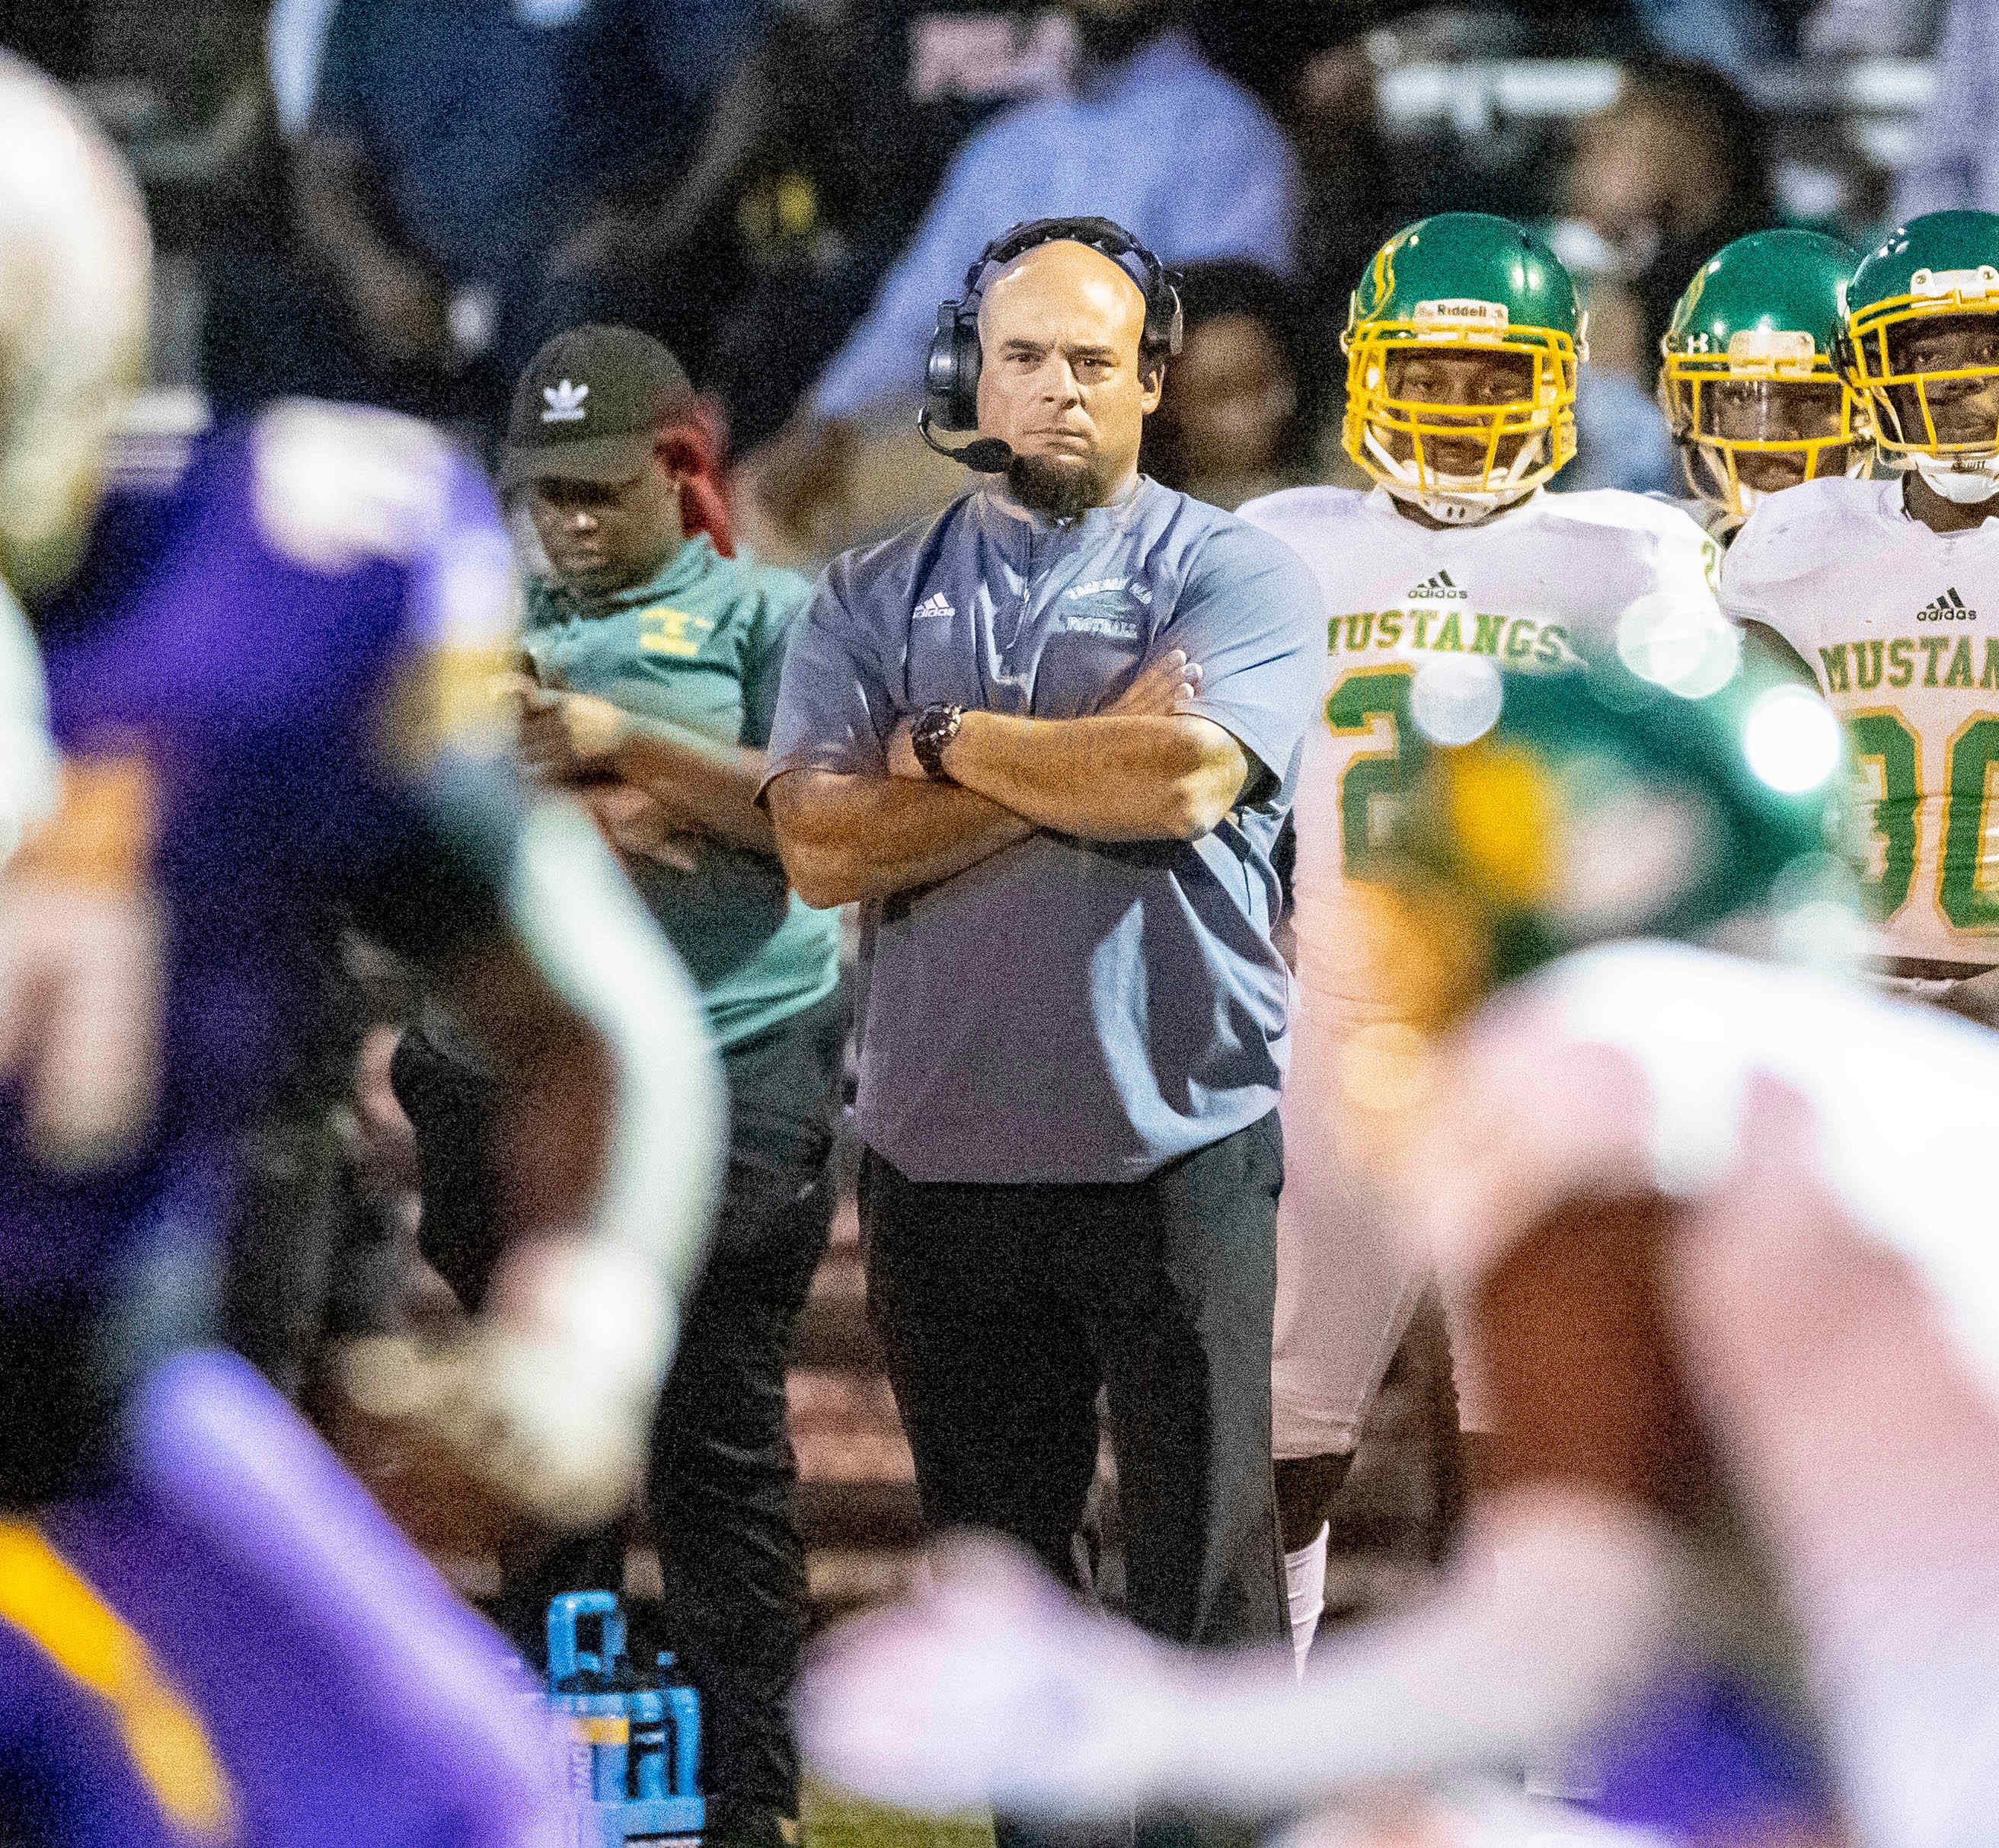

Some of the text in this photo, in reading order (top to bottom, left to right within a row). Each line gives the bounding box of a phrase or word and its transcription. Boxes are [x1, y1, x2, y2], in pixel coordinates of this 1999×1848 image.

[1437, 303, 1487, 318] Riddell
[1407, 589, 1467, 599] adidas
[1916, 607, 1977, 622] adidas
